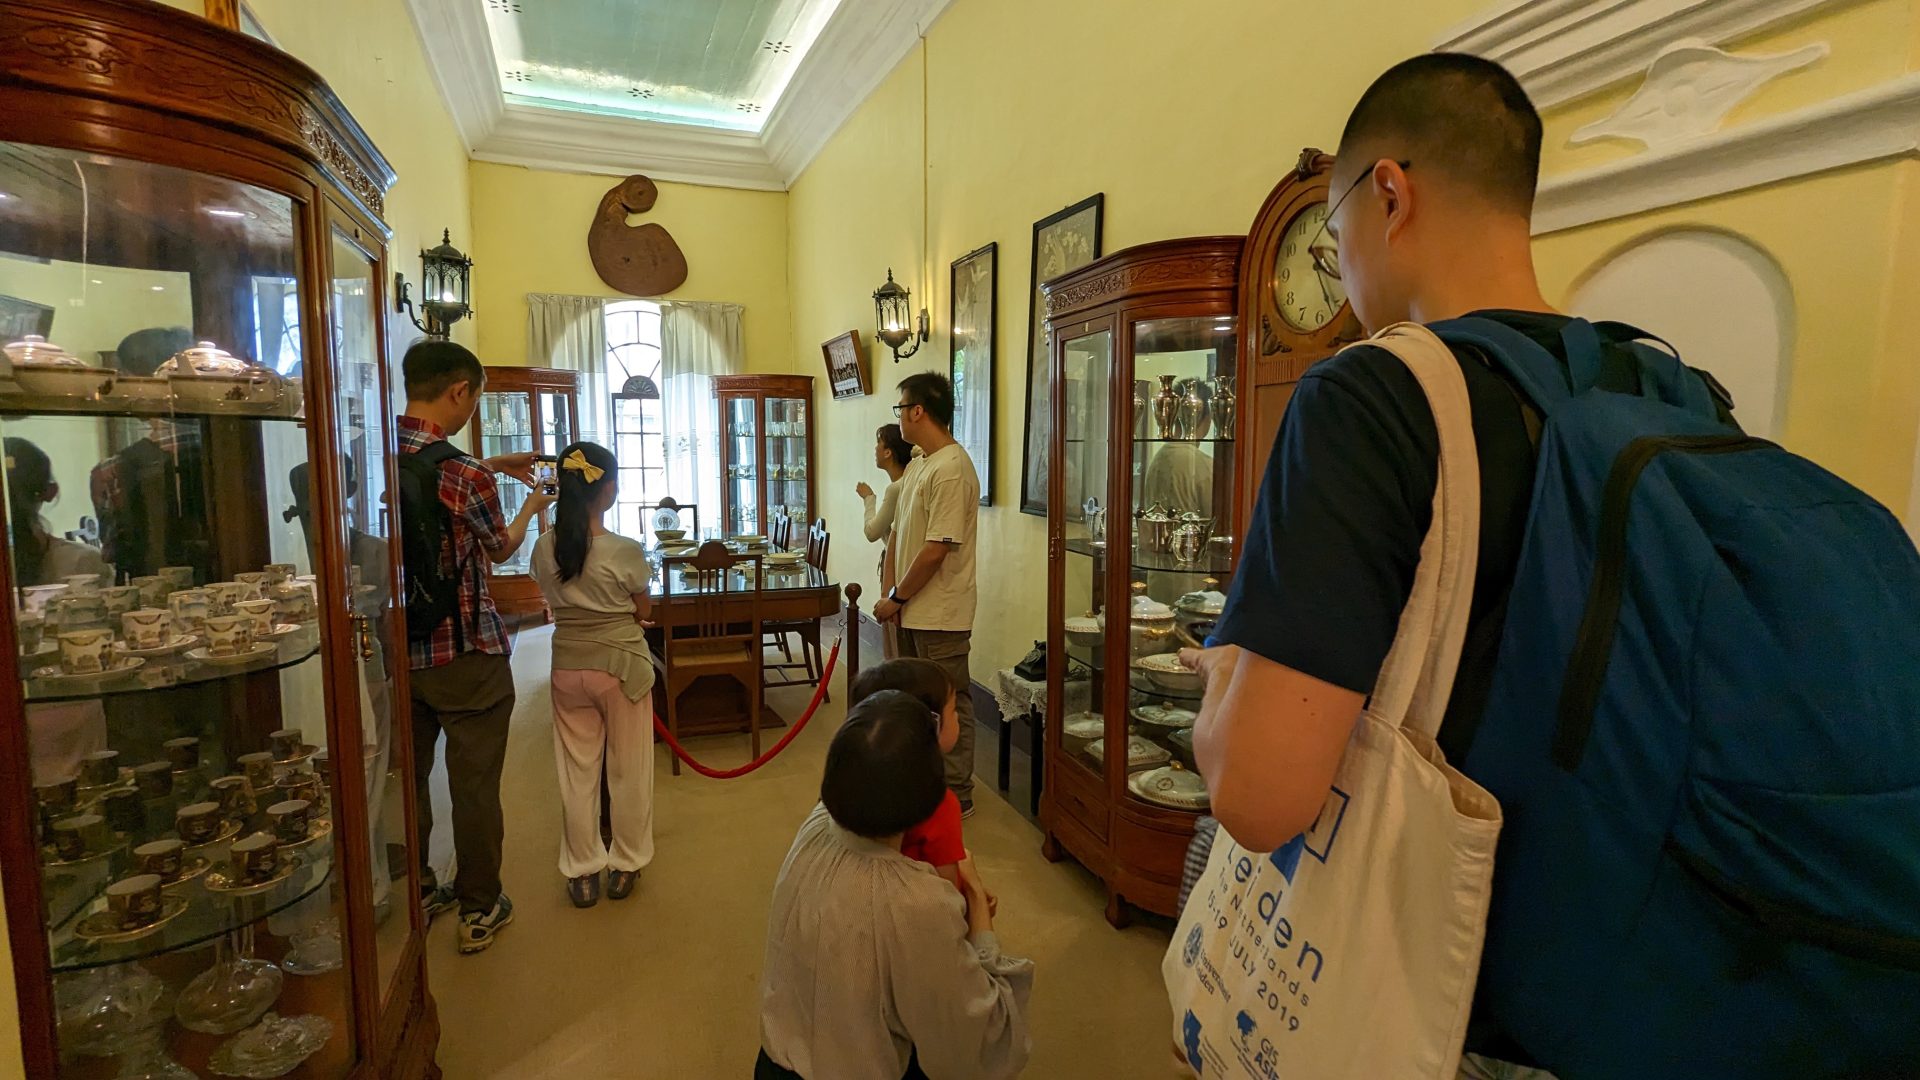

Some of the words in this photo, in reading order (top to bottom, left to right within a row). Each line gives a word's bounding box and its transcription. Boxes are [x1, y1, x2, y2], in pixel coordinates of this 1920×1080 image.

[1299, 221, 1306, 235] 11
[1285, 243, 1297, 258] 10
[1282, 268, 1290, 283] 9
[1286, 291, 1295, 306] 8
[1299, 306, 1307, 321] 7
[1315, 310, 1324, 325] 6
[1229, 935, 1257, 977] JULY
[1257, 981, 1300, 1032] 2019
[1260, 1038, 1279, 1067] GIS
